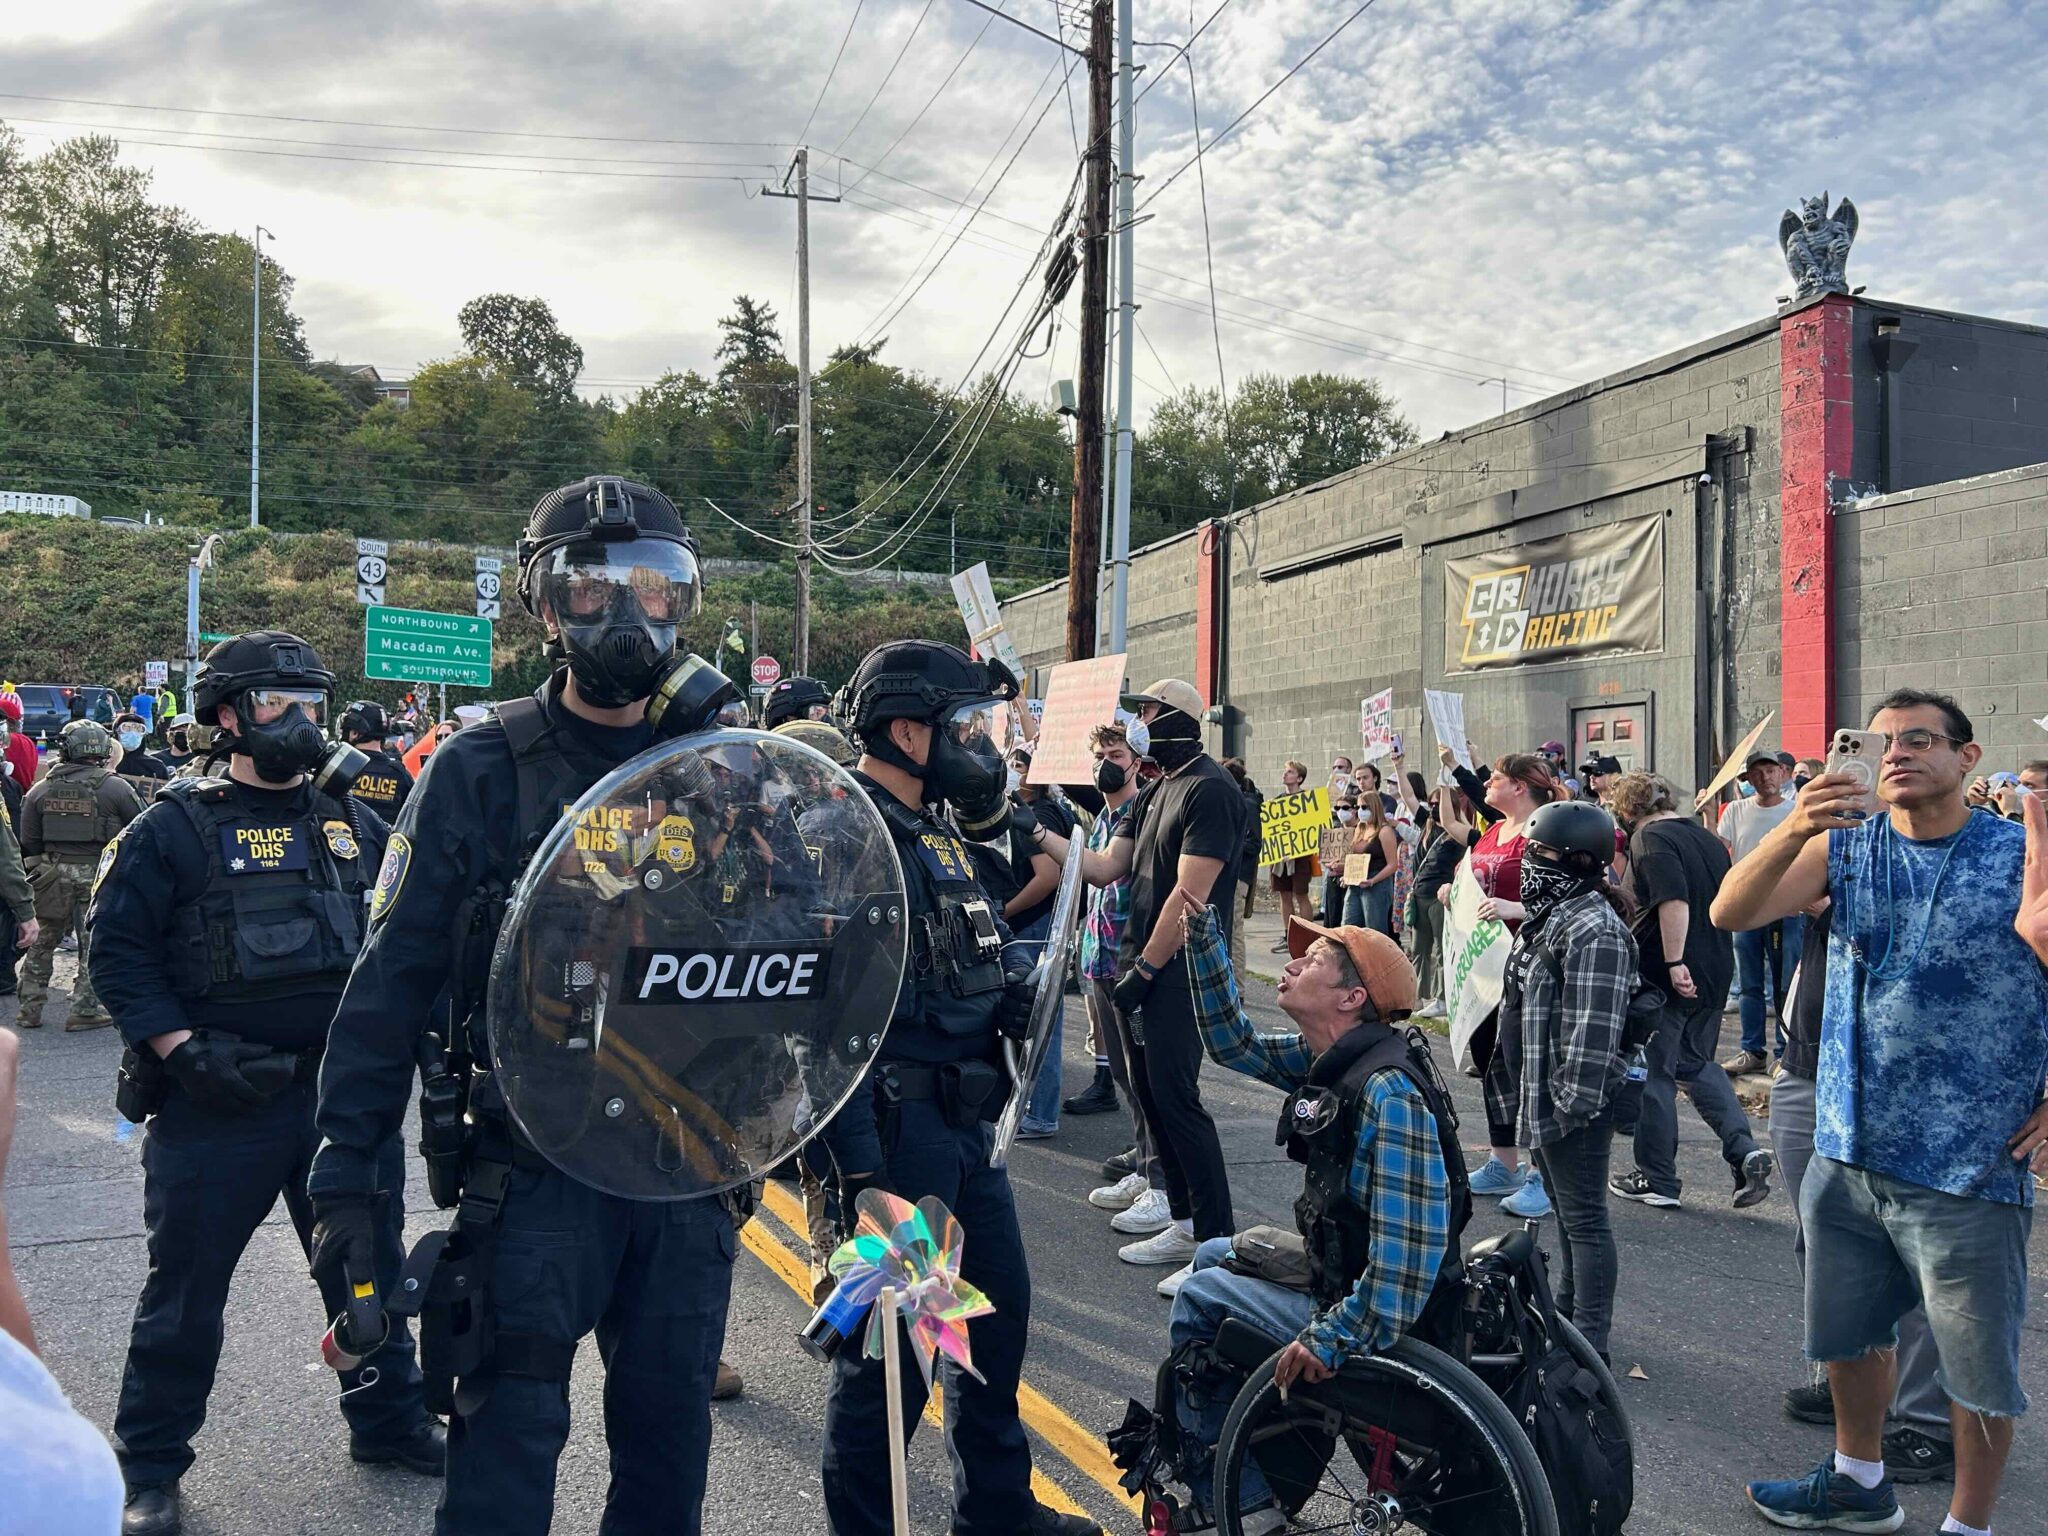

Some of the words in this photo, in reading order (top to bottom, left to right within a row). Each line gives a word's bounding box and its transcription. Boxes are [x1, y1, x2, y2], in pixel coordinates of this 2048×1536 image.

[360, 541, 386, 553] SOUTH
[362, 561, 382, 578] 43
[479, 559, 498, 569] NORTH
[480, 578, 498, 594] 43
[381, 614, 459, 631] NORTHBOUND
[1523, 605, 1618, 650] RACING
[381, 638, 446, 655] Macadam
[453, 645, 482, 658] Ave.
[402, 664, 480, 679] SOUTHBOUND
[753, 665, 778, 676] STOP
[1374, 711, 1390, 727] WITH
[44, 800, 80, 811] POLICE
[1260, 789, 1318, 823] SCISM
[236, 828, 294, 844] POLICE
[665, 827, 689, 837] DHS
[1268, 820, 1291, 836] IS
[574, 827, 618, 852] DHS
[1322, 831, 1349, 844] FUCK
[250, 843, 285, 859] DHS
[260, 859, 280, 868] 1164
[584, 861, 606, 874] 1723
[638, 953, 819, 999] POLICE
